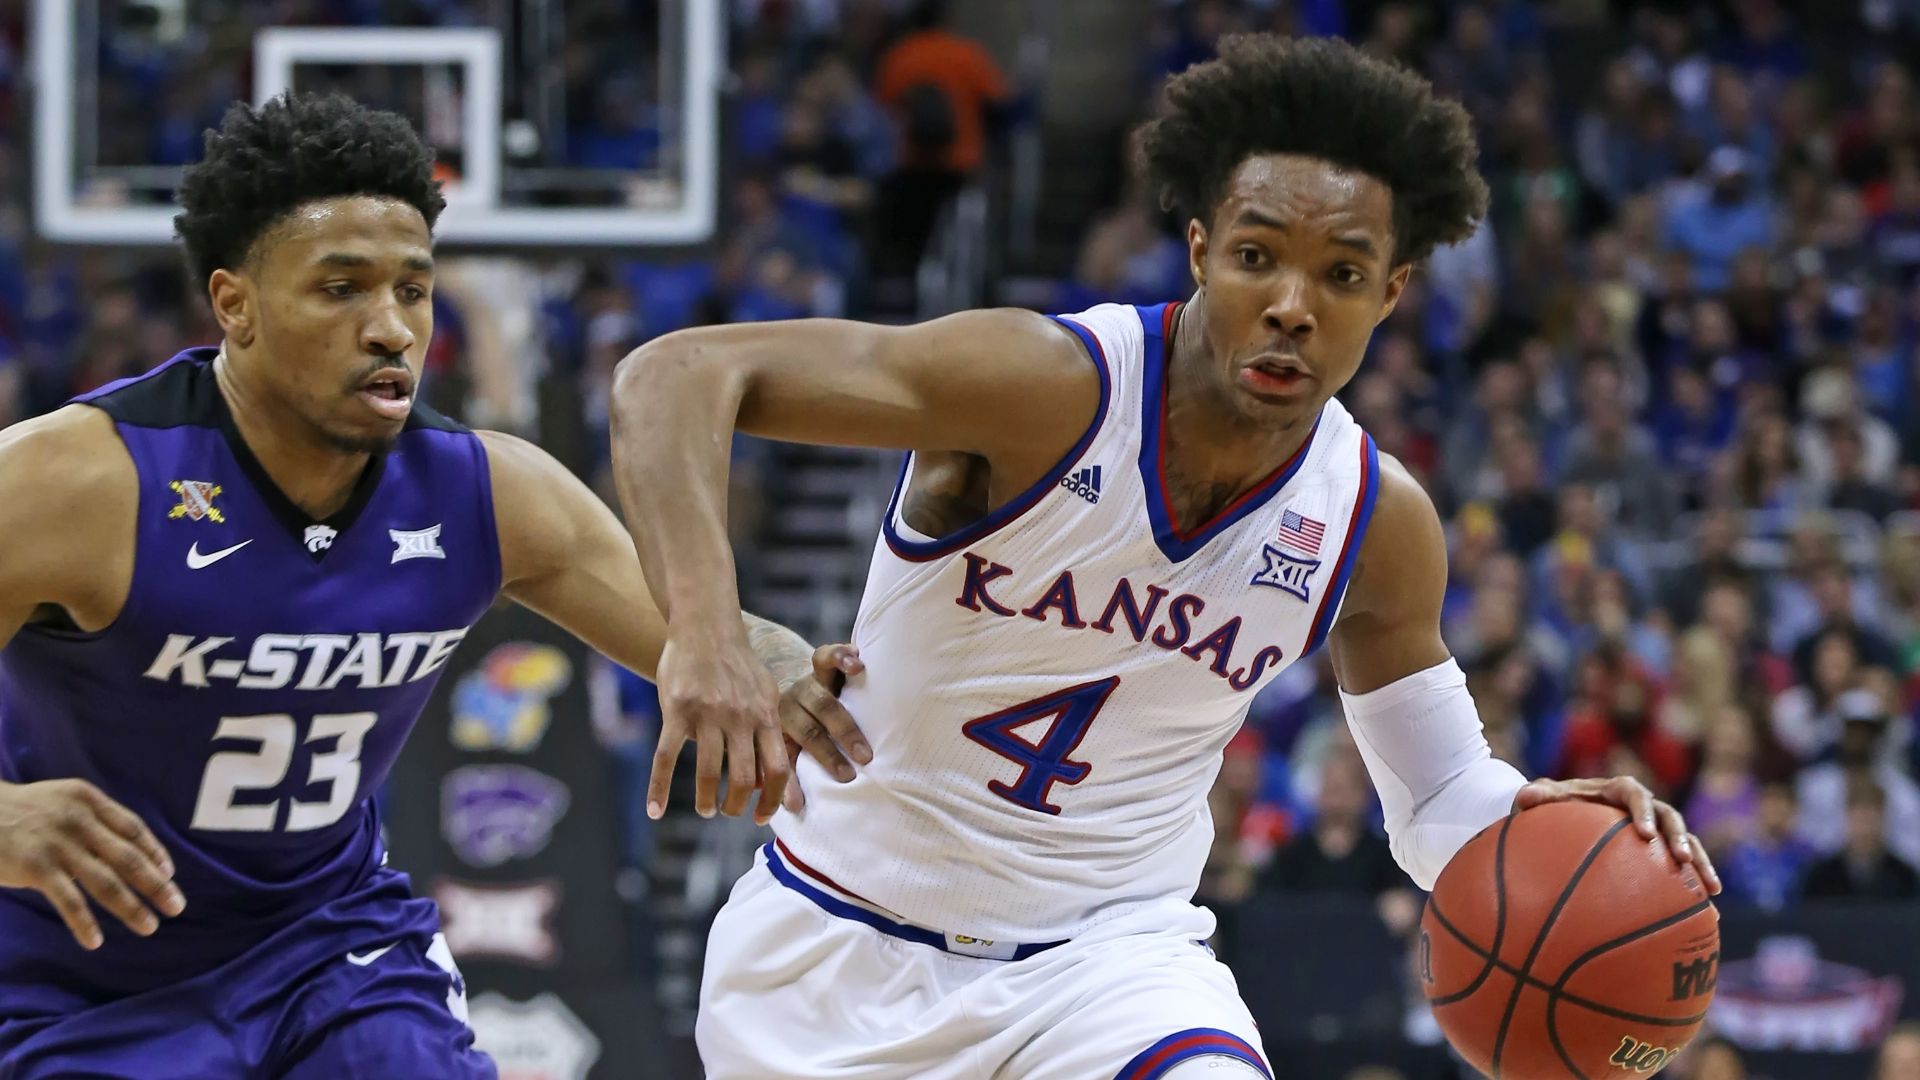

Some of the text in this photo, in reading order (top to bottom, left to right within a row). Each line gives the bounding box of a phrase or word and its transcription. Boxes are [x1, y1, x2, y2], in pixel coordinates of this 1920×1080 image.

[1061, 477, 1100, 504] adidas
[1255, 546, 1319, 600] XII
[143, 625, 470, 690] K-STATE
[955, 551, 1283, 691] KANSAS
[189, 711, 378, 832] 23
[961, 675, 1120, 815] 4
